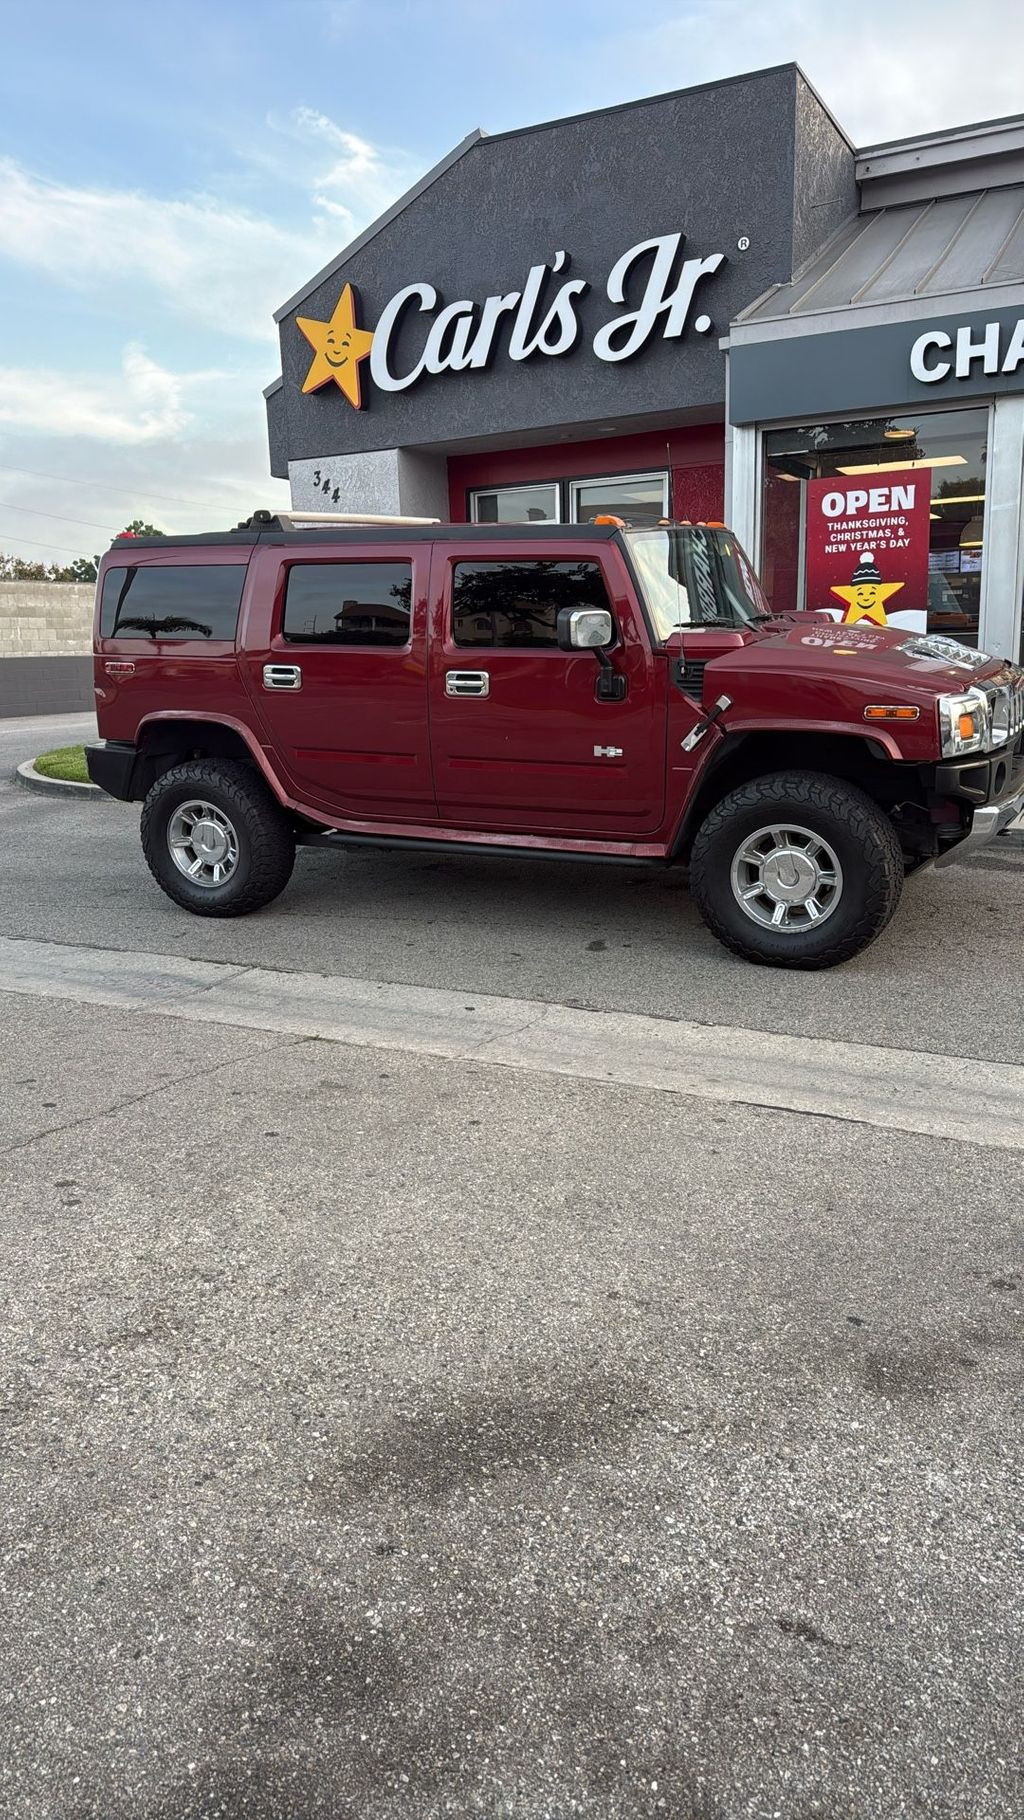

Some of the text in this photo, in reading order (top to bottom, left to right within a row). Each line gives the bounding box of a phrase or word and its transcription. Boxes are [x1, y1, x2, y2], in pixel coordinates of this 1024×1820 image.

[370, 250, 588, 392] Carl's
[593, 232, 725, 362] Jr.
[313, 470, 341, 503] 344
[821, 485, 916, 517] OPEN
[827, 516, 909, 531] THANKSGIVING,
[830, 528, 905, 542] CHRISTMAS, &
[825, 538, 910, 553] NEW YEAR'S DAY
